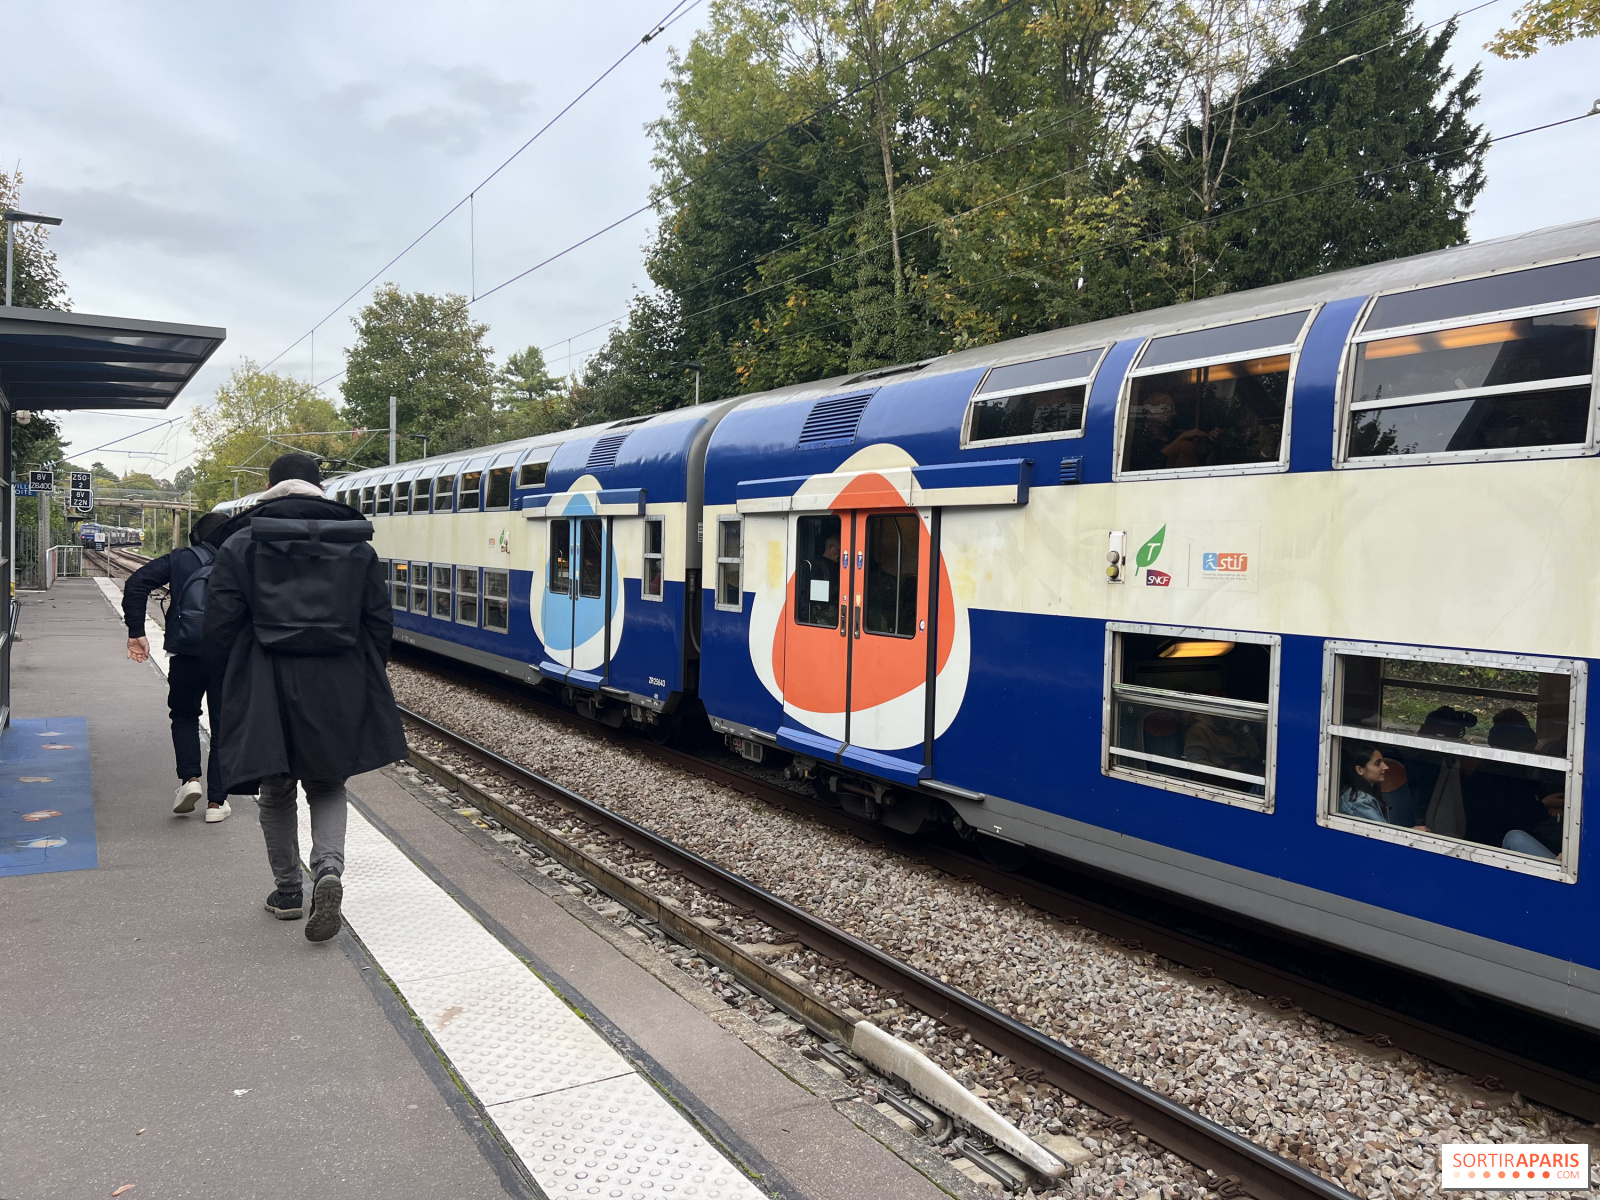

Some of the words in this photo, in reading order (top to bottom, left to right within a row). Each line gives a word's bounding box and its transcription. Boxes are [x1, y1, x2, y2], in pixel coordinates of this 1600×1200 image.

[1147, 543, 1160, 561] T
[1220, 554, 1248, 570] stif
[1147, 575, 1169, 585] SNCF
